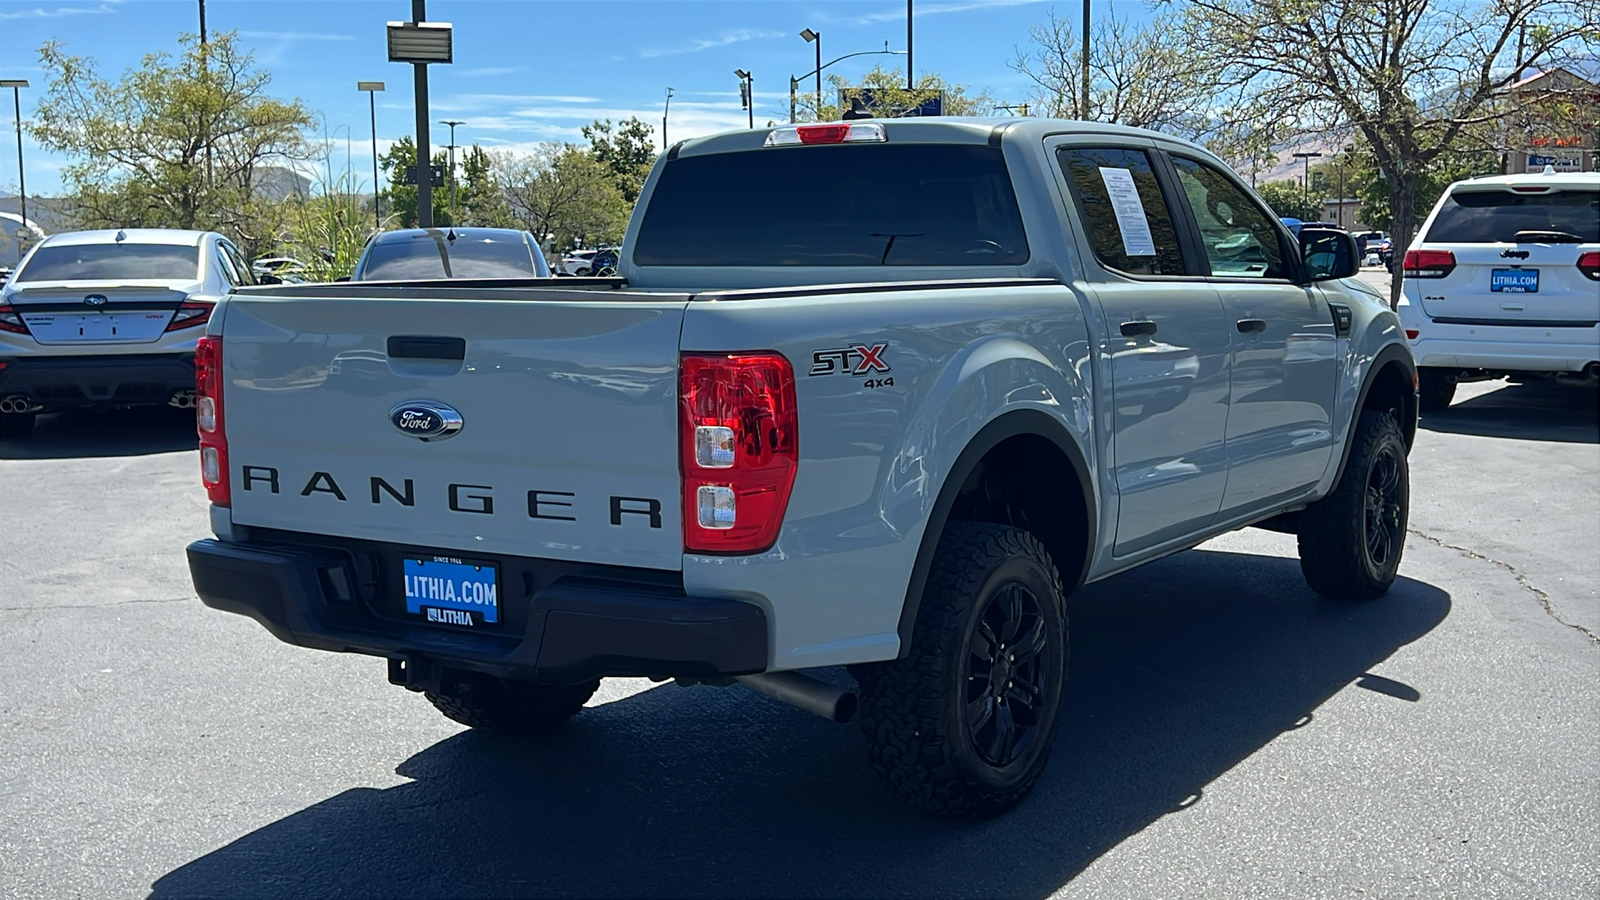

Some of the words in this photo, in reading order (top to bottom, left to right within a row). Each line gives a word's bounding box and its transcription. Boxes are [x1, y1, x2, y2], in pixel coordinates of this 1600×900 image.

[1492, 276, 1537, 286] LITHIA.COM
[809, 342, 892, 377] STX
[400, 410, 431, 429] Ford
[242, 464, 662, 529] RANGER
[433, 556, 449, 564] SINCE
[449, 557, 462, 565] 1946
[404, 574, 497, 607] LITHIA.COM
[437, 608, 474, 626] LITHIA
